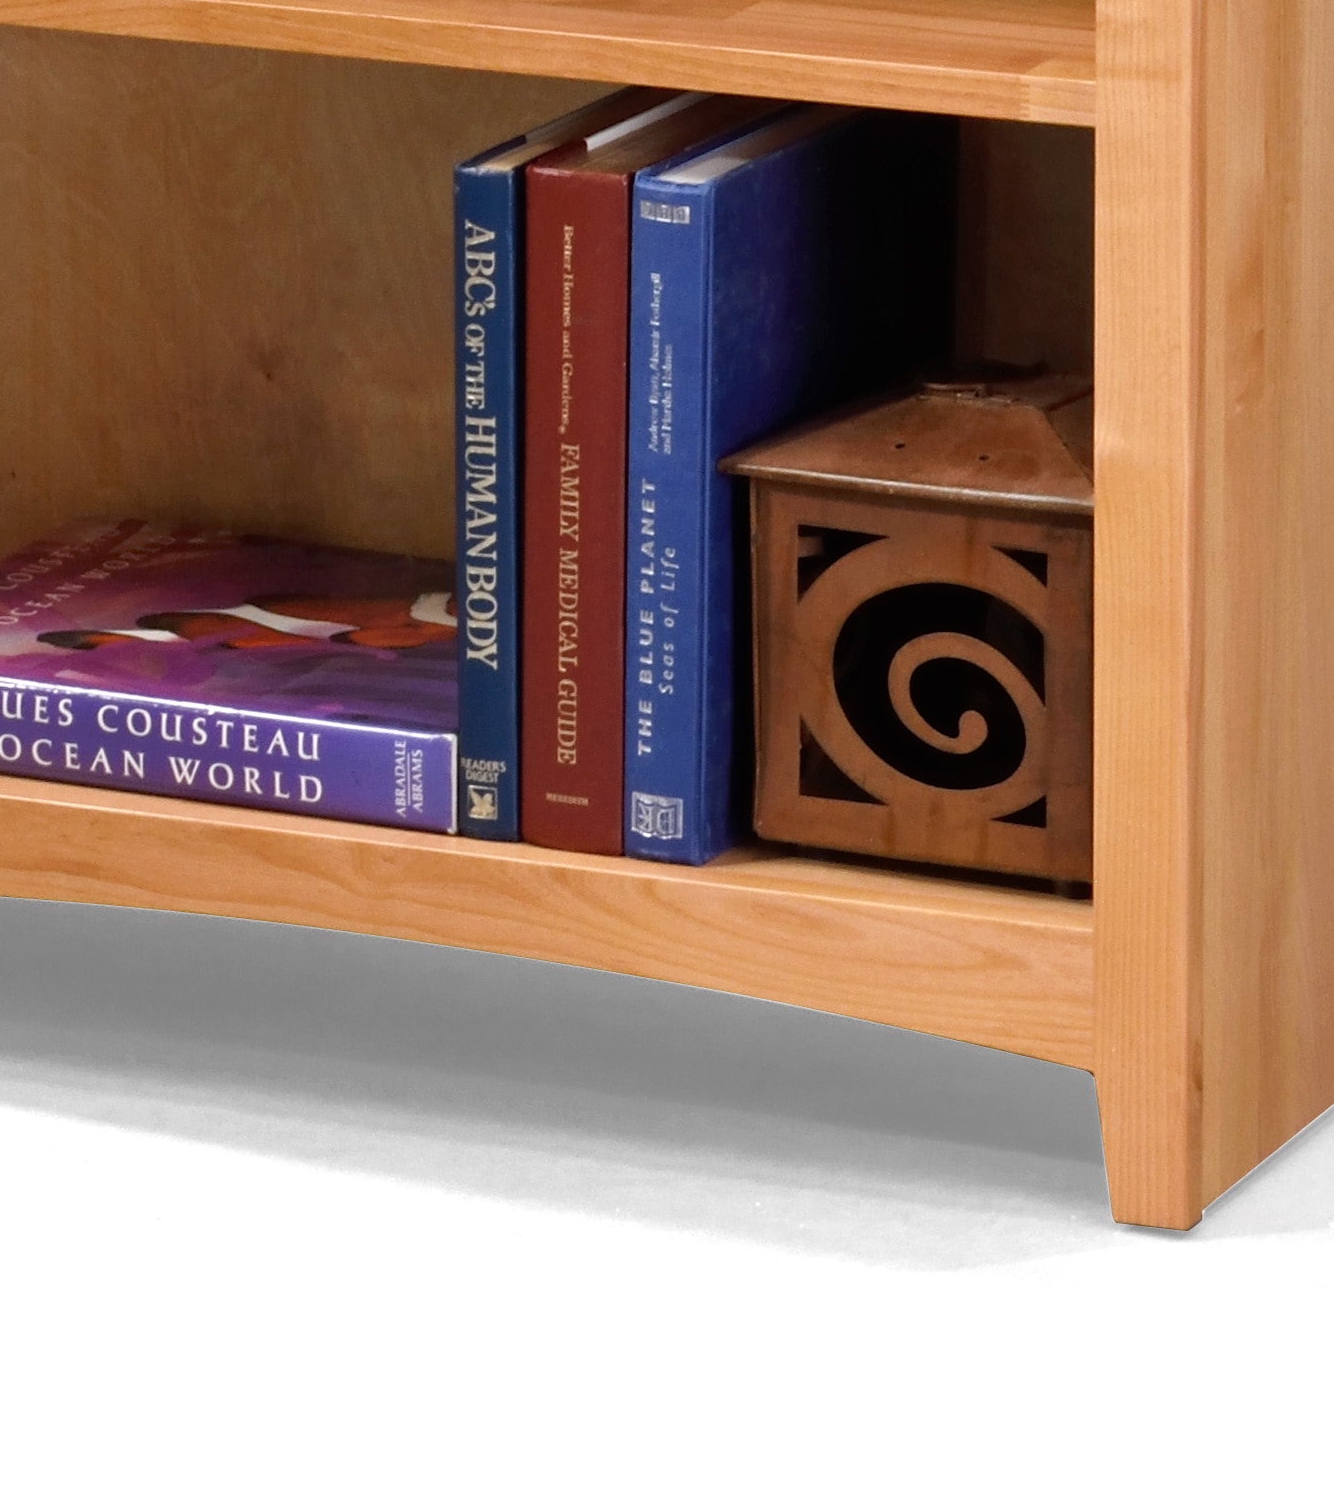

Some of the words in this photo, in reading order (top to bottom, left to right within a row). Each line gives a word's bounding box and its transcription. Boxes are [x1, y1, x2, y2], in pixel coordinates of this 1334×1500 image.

[464, 219, 496, 318] ABC's
[563, 225, 574, 271] Better
[563, 273, 574, 328] Homes
[464, 323, 486, 358] OF
[562, 330, 573, 359] and
[464, 359, 486, 410] THE
[464, 414, 498, 562] HUMAN
[559, 443, 580, 542] FAMILY
[640, 478, 656, 594] PLANET
[661, 547, 679, 592] Life
[464, 565, 498, 671] BODY
[558, 547, 579, 673] MEDICAL
[660, 602, 679, 628] of
[639, 609, 655, 685] BLUE
[658, 643, 674, 696] Seas
[97, 704, 322, 763] COUSTEAU
[557, 677, 578, 765] GUIDE
[637, 699, 654, 756] THE
[168, 755, 324, 804] WORLD
[394, 740, 407, 818] ABRADALE
[411, 749, 424, 813] ABRAMS
[465, 769, 500, 785] DIGEST
